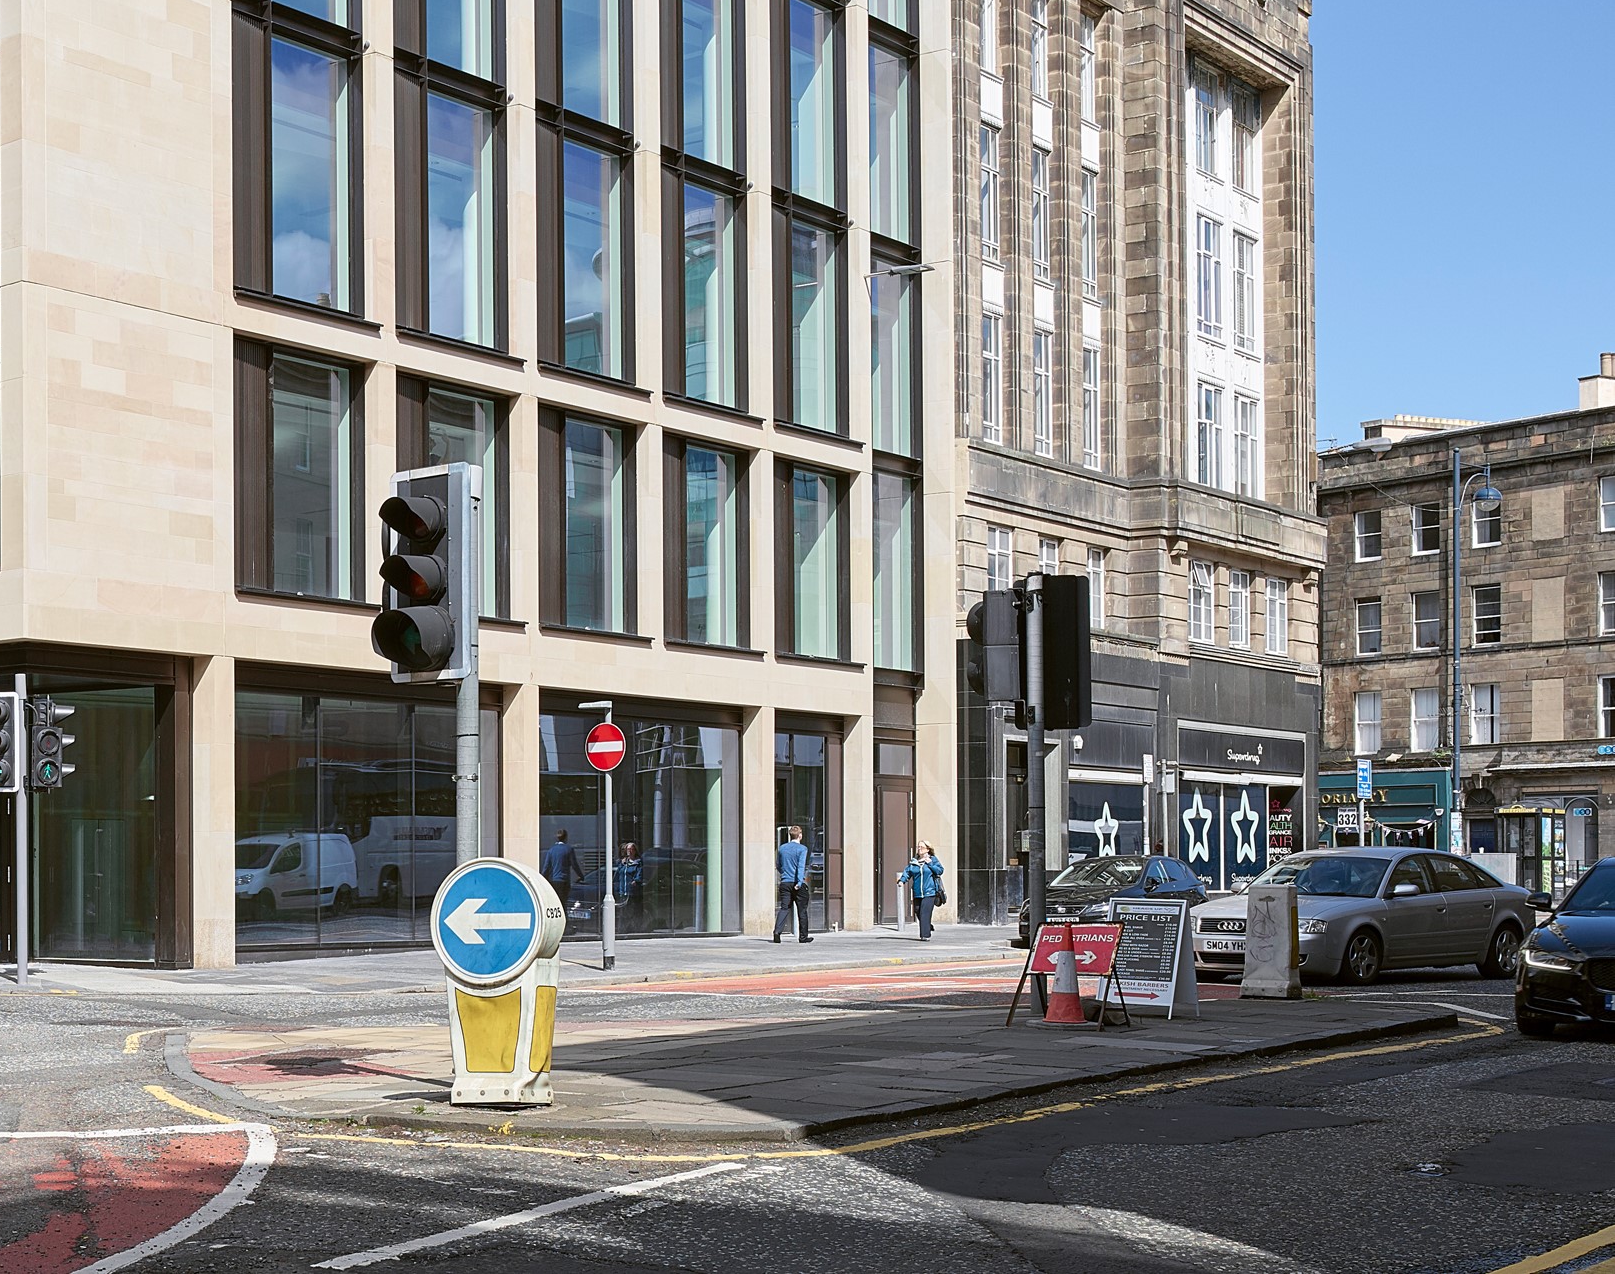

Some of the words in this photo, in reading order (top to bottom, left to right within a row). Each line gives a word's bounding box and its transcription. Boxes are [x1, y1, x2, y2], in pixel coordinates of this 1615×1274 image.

[1227, 749, 1260, 766] Superdrug
[1321, 789, 1389, 804] ORIAY
[1338, 814, 1356, 826] 332
[1269, 836, 1292, 847] AIR
[1231, 872, 1256, 883] Superdr
[1042, 934, 1114, 943] PEDTRIANS
[1206, 940, 1229, 950] SM04
